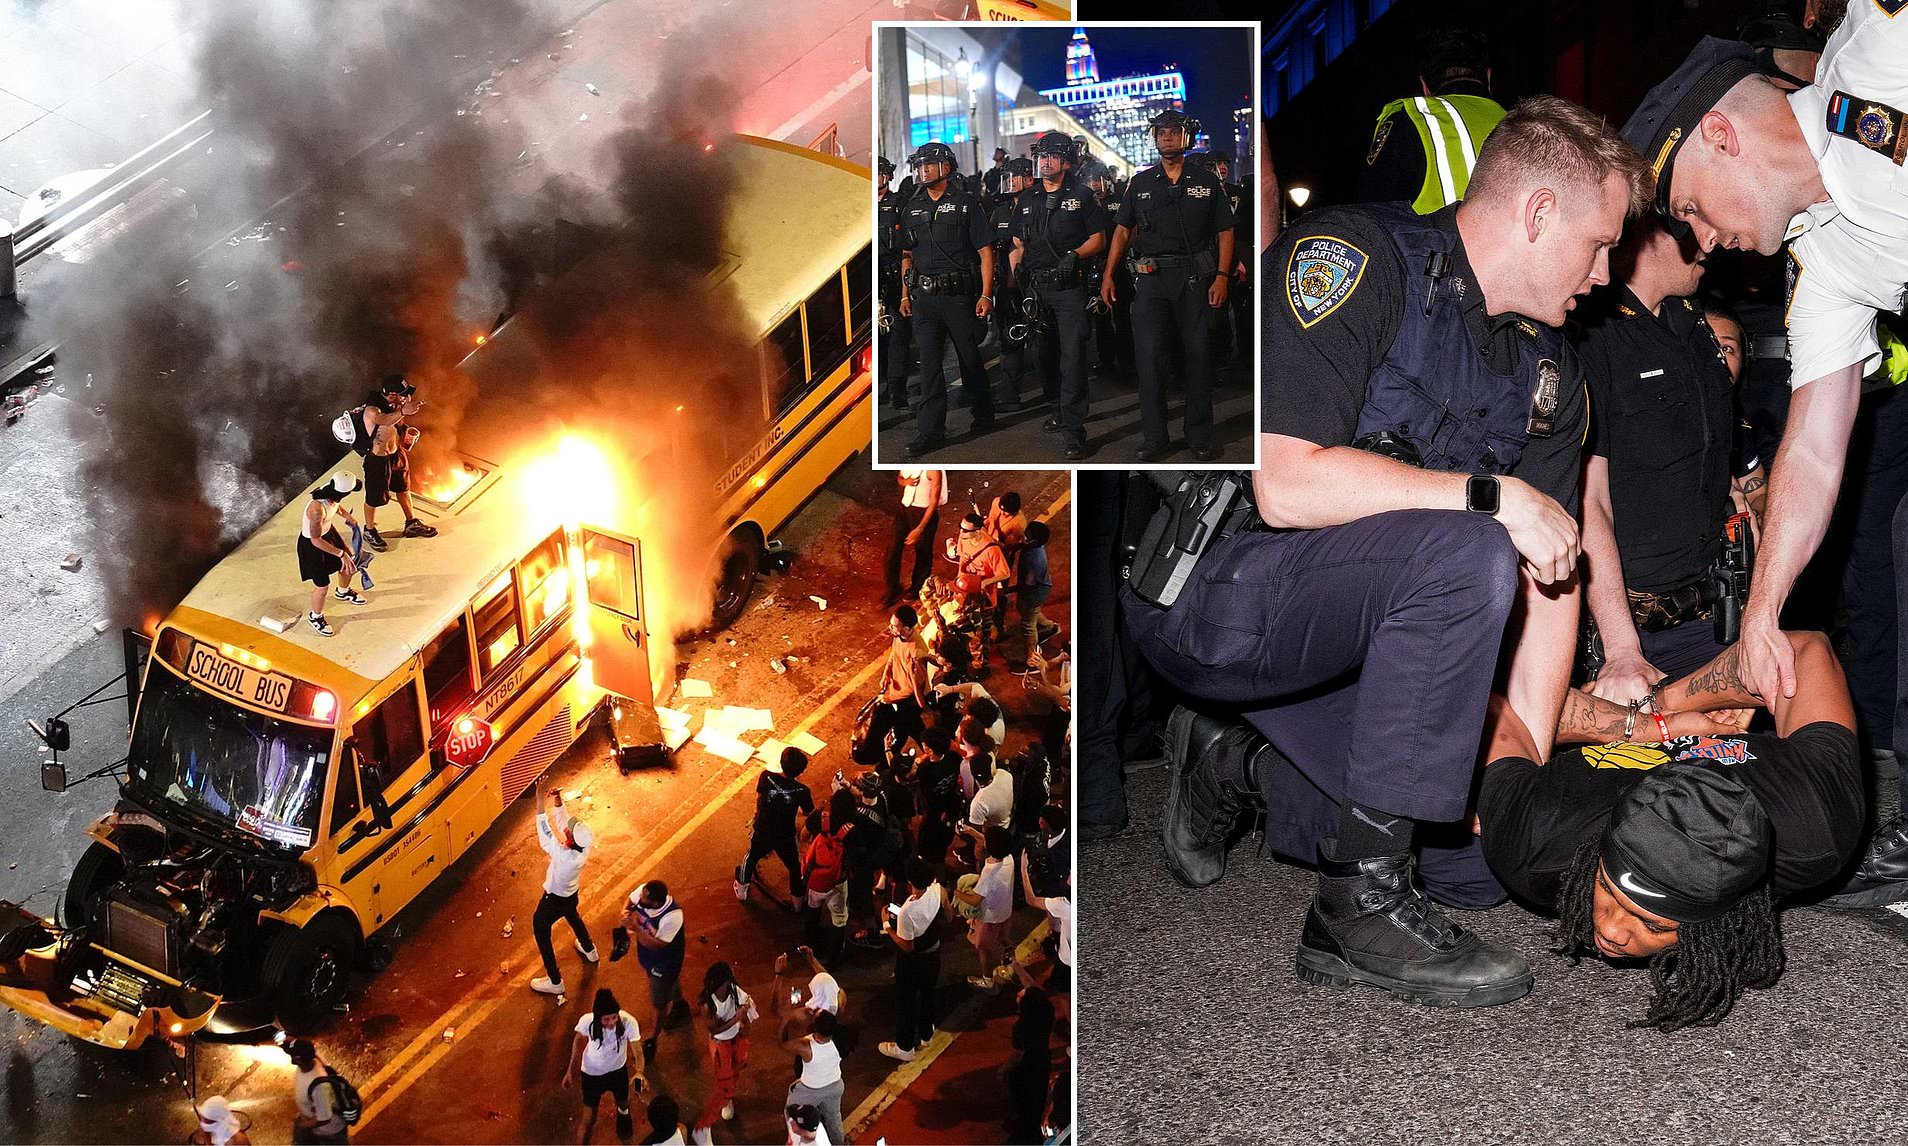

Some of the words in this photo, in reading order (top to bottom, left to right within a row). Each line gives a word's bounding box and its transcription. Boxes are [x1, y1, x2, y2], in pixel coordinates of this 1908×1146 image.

[1187, 187, 1211, 195] POLICE
[1296, 249, 1357, 272] DEPARTMENT
[1311, 241, 1348, 257] POLICE
[1290, 271, 1298, 293] CITY
[1293, 295, 1303, 308] OF
[1313, 299, 1333, 316] NEW
[1332, 277, 1354, 301] YORK
[713, 449, 763, 494] STUDENT
[764, 426, 785, 448] INC.
[191, 650, 245, 695] SCHOOL
[254, 676, 287, 708] BUS
[484, 666, 525, 713] NT8617
[450, 729, 486, 756] STOP
